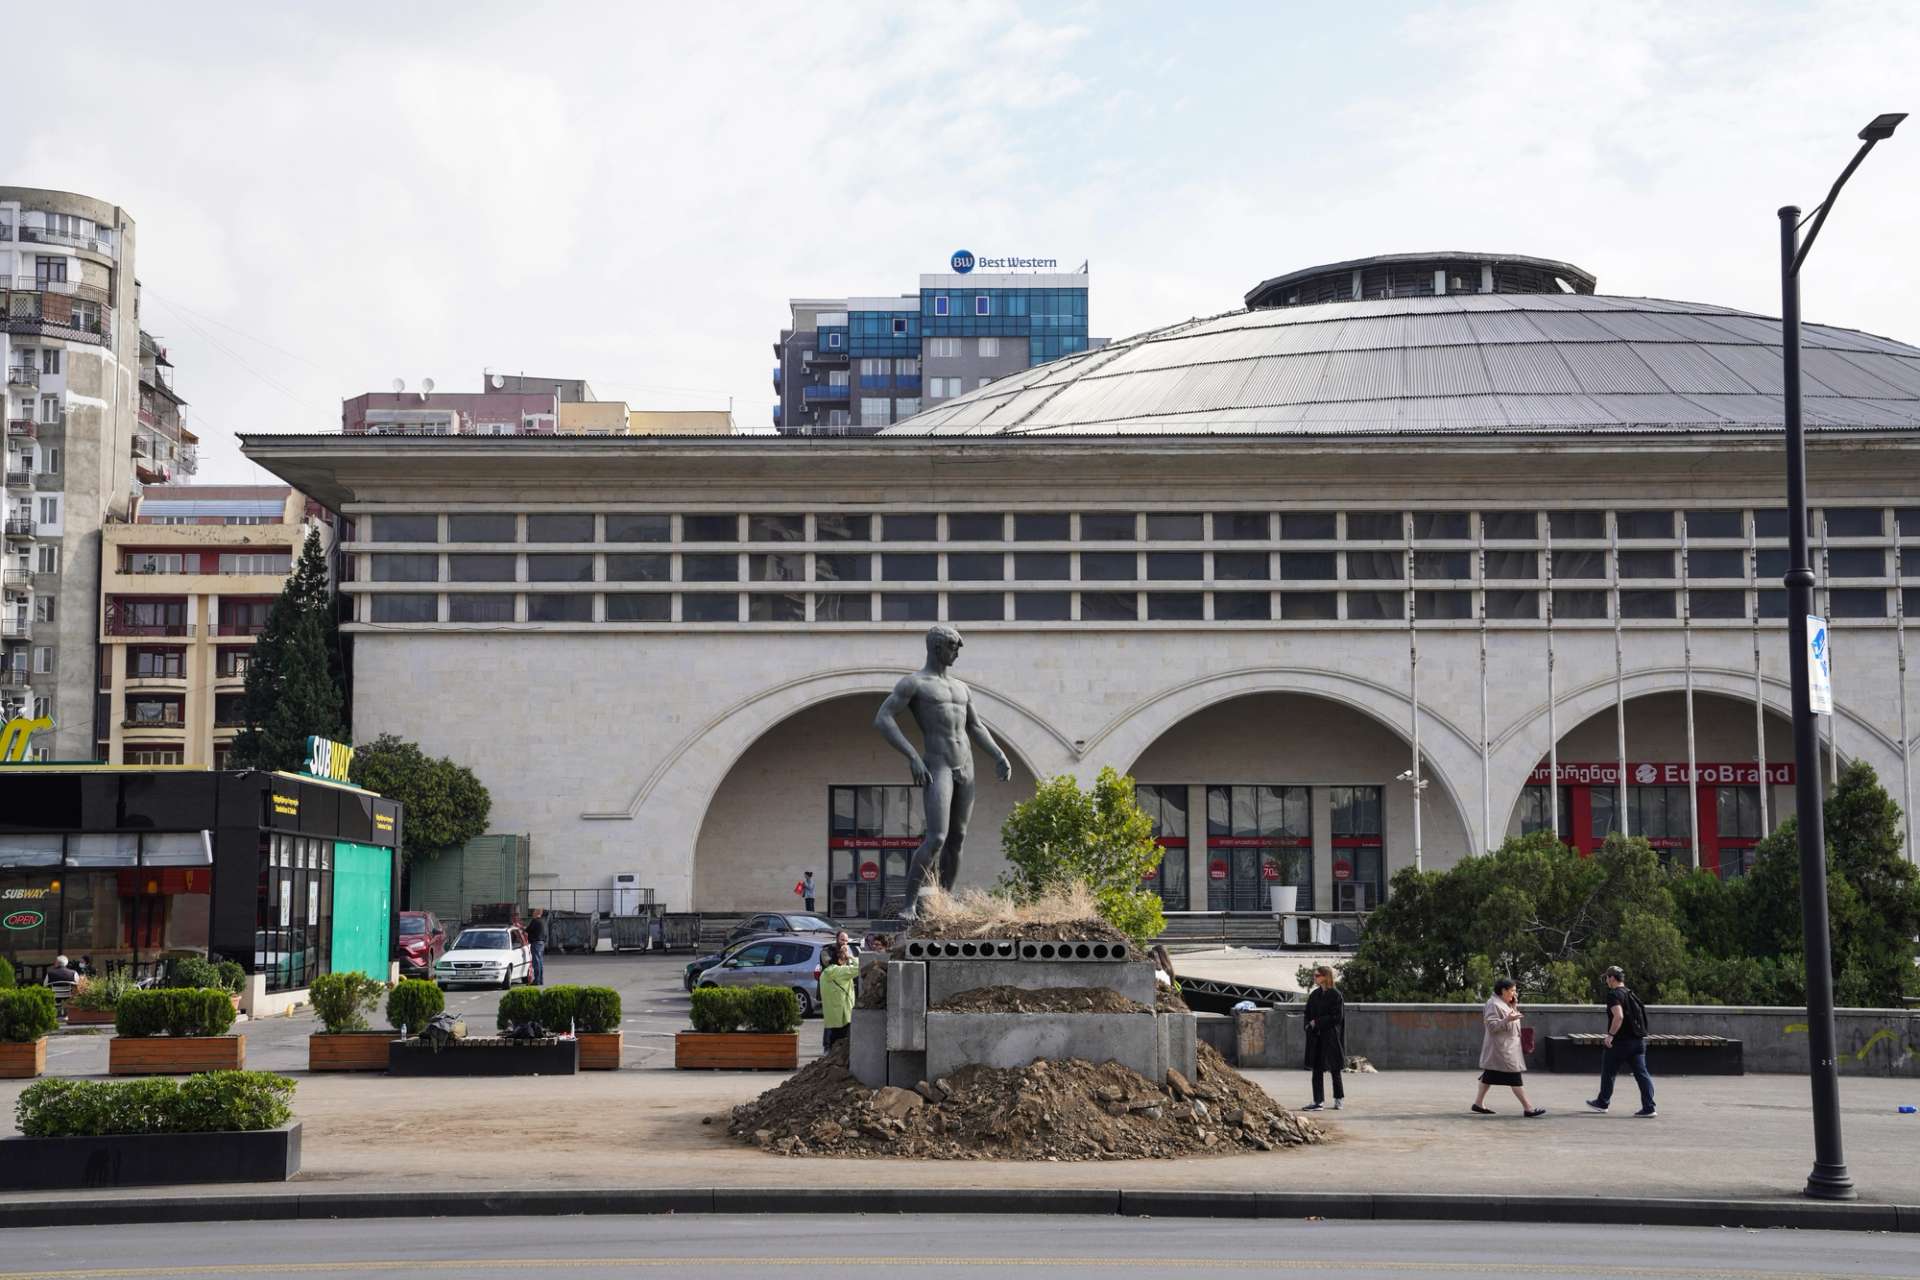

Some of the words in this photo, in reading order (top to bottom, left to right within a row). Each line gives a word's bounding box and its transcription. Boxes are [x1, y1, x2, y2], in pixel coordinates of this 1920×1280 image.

[954, 257, 973, 267] BW
[979, 257, 1005, 267] Best
[1008, 257, 1057, 267] Western
[310, 736, 354, 783] SUBWAY
[1665, 765, 1789, 782] EuroBrand
[1, 888, 49, 899] SUBWAY
[9, 915, 38, 925] OPEN
